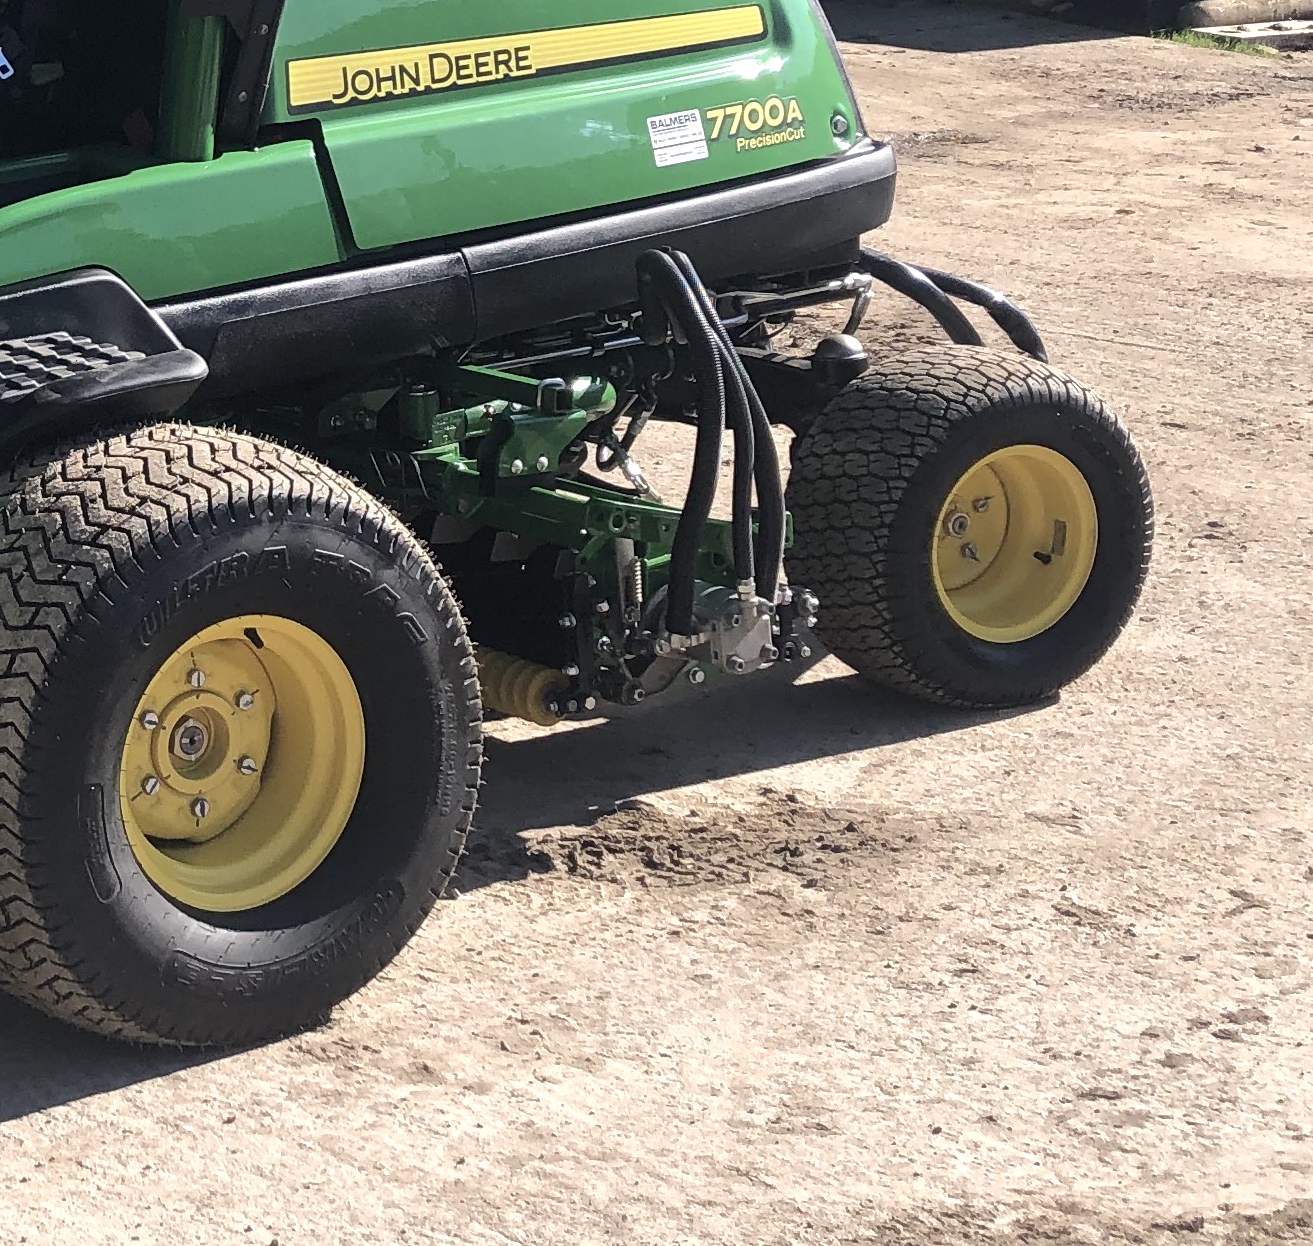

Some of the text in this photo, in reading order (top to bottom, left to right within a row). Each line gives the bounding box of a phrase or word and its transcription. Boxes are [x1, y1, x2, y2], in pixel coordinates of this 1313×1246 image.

[332, 45, 533, 100] JOHN DEERE
[650, 112, 698, 130] BALMERS
[706, 97, 804, 140] 7700A
[736, 125, 805, 152] PrecisionCut
